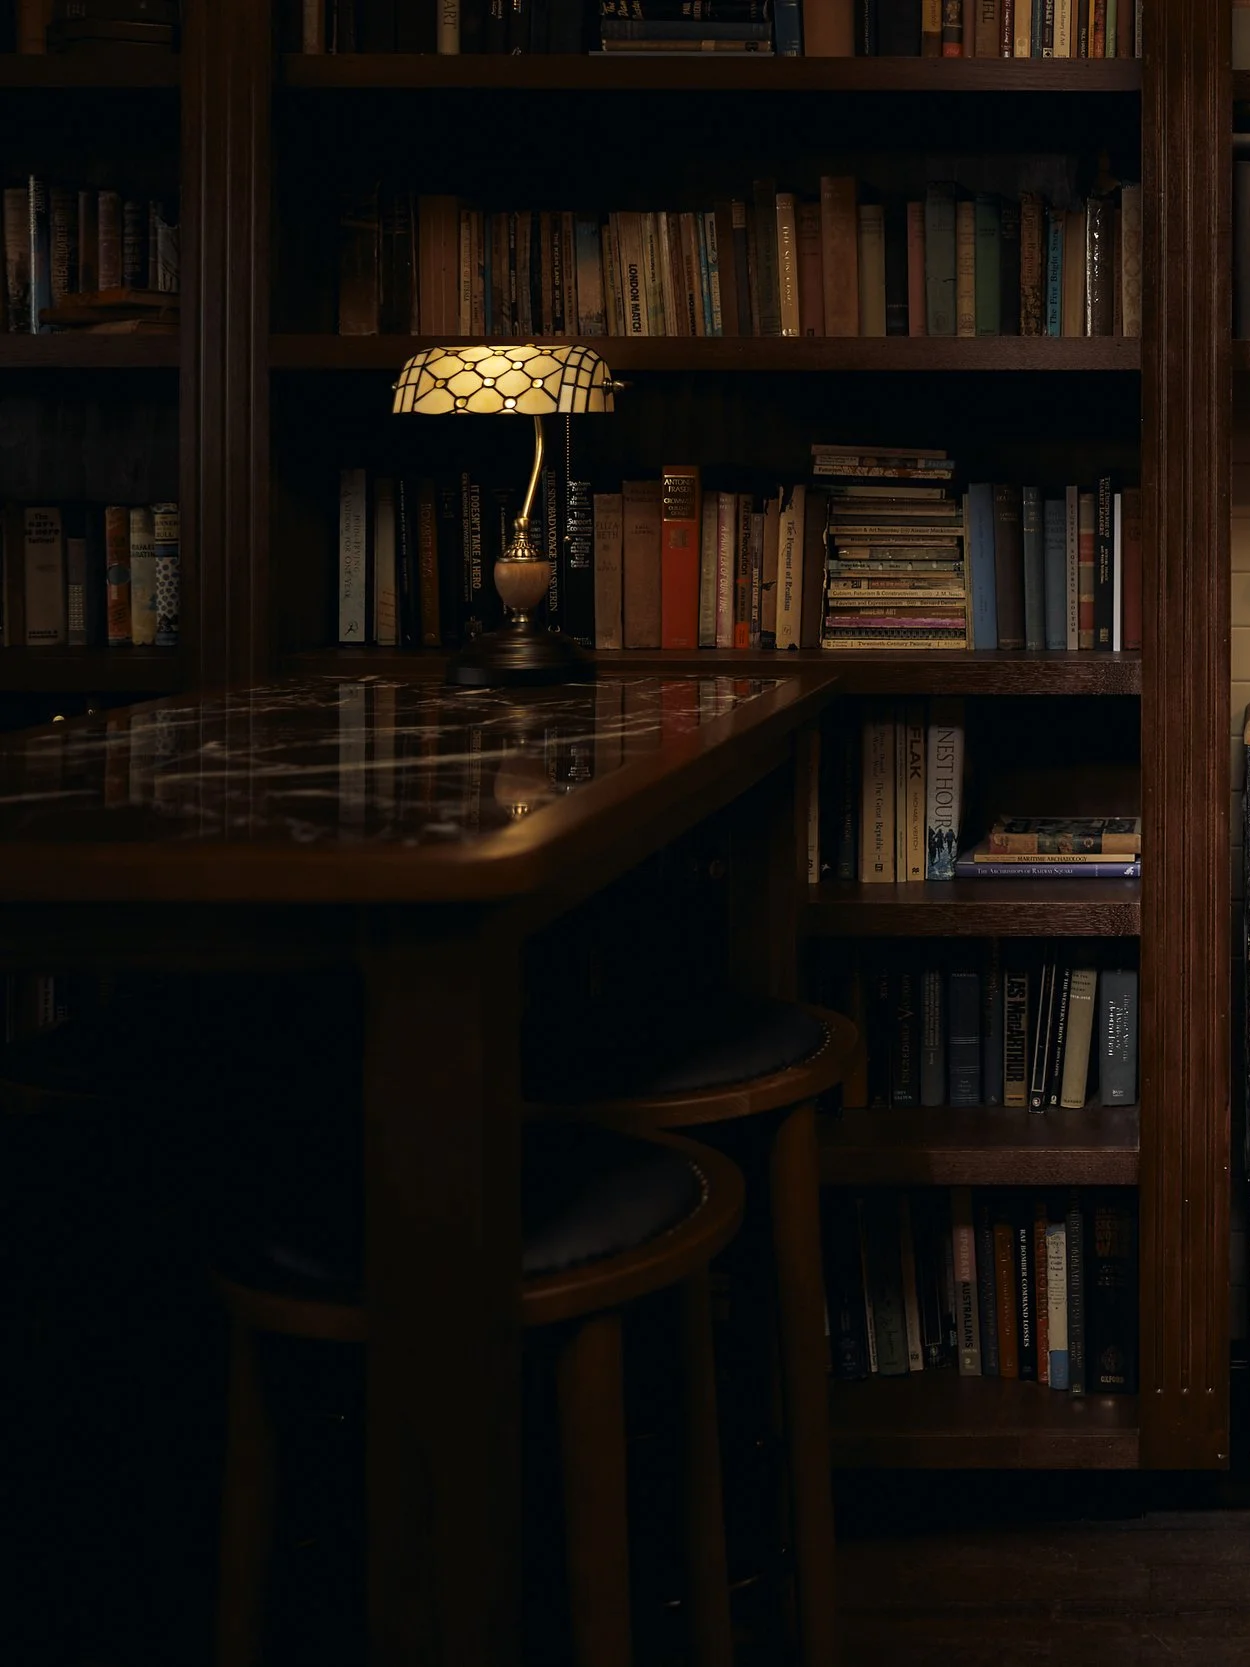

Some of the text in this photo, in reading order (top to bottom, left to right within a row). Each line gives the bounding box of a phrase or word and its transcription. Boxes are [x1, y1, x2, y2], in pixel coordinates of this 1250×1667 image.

[1050, 256, 1059, 282] Bright
[628, 263, 642, 333] LONDON MATCH
[471, 484, 480, 492] IT
[548, 470, 558, 488] THE
[471, 495, 481, 531] DOESN'T
[548, 488, 558, 526] SINDBAD
[420, 503, 432, 548] BOMBER
[742, 500, 752, 575] Art and Revolution
[472, 533, 481, 556] TAKE
[548, 526, 558, 558] VOYAGE
[720, 532, 730, 565] PAINTER
[785, 537, 795, 569] Ferment
[472, 566, 482, 590] HERO
[720, 579, 730, 594] OUR
[721, 567, 729, 577] OF
[548, 576, 558, 612] SEVERIN
[719, 596, 730, 615] TIME
[784, 581, 793, 612] Realism
[909, 726, 922, 780] FLAK
[873, 782, 884, 852] The Great Republic
[934, 778, 954, 831] HOUR
[1060, 992, 1068, 1022] WESTERN
[1006, 1000, 1026, 1082] MacARTHUR
[1056, 1022, 1064, 1044] FRONT
[1019, 1228, 1030, 1347] RAF BOMBER COMMAND LOSSES
[961, 1281, 974, 1349] AUSTRALIANS
